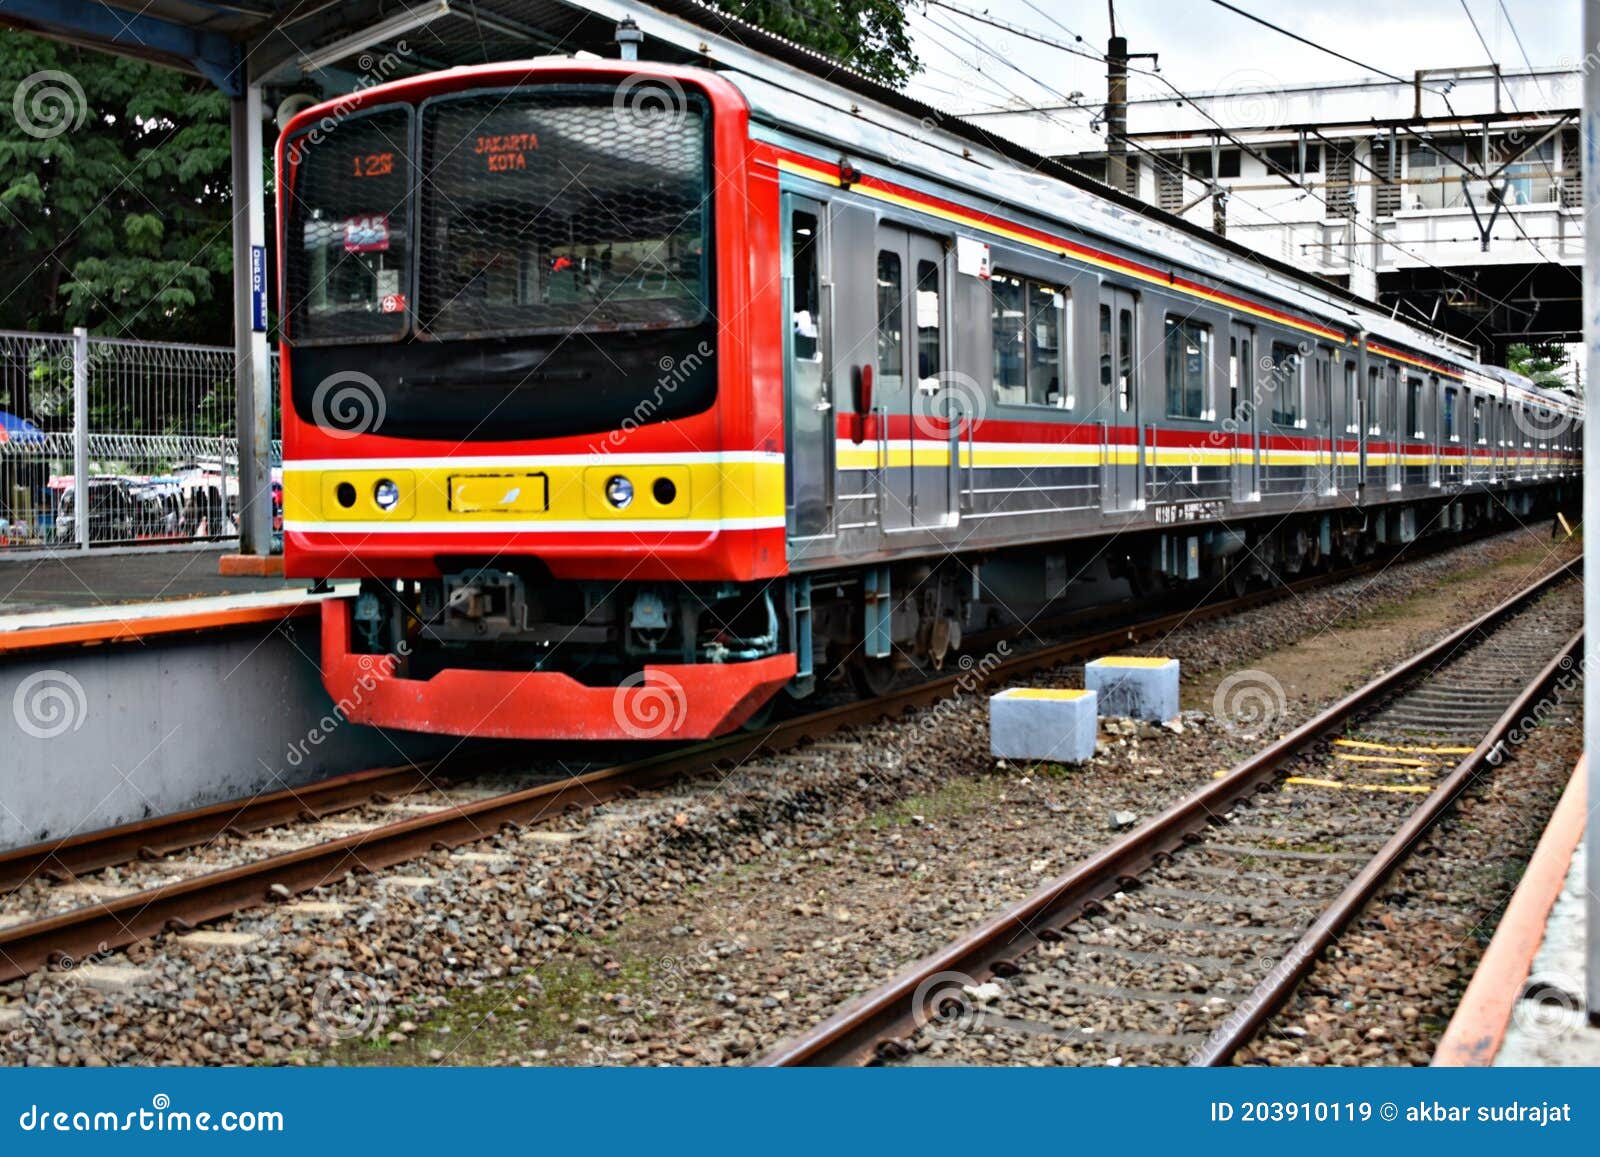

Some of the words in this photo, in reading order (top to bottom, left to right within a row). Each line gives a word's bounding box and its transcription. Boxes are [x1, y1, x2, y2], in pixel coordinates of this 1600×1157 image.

[475, 133, 539, 154] JAKARTA
[488, 152, 527, 171] KOTA
[253, 249, 261, 292] DEPOK
